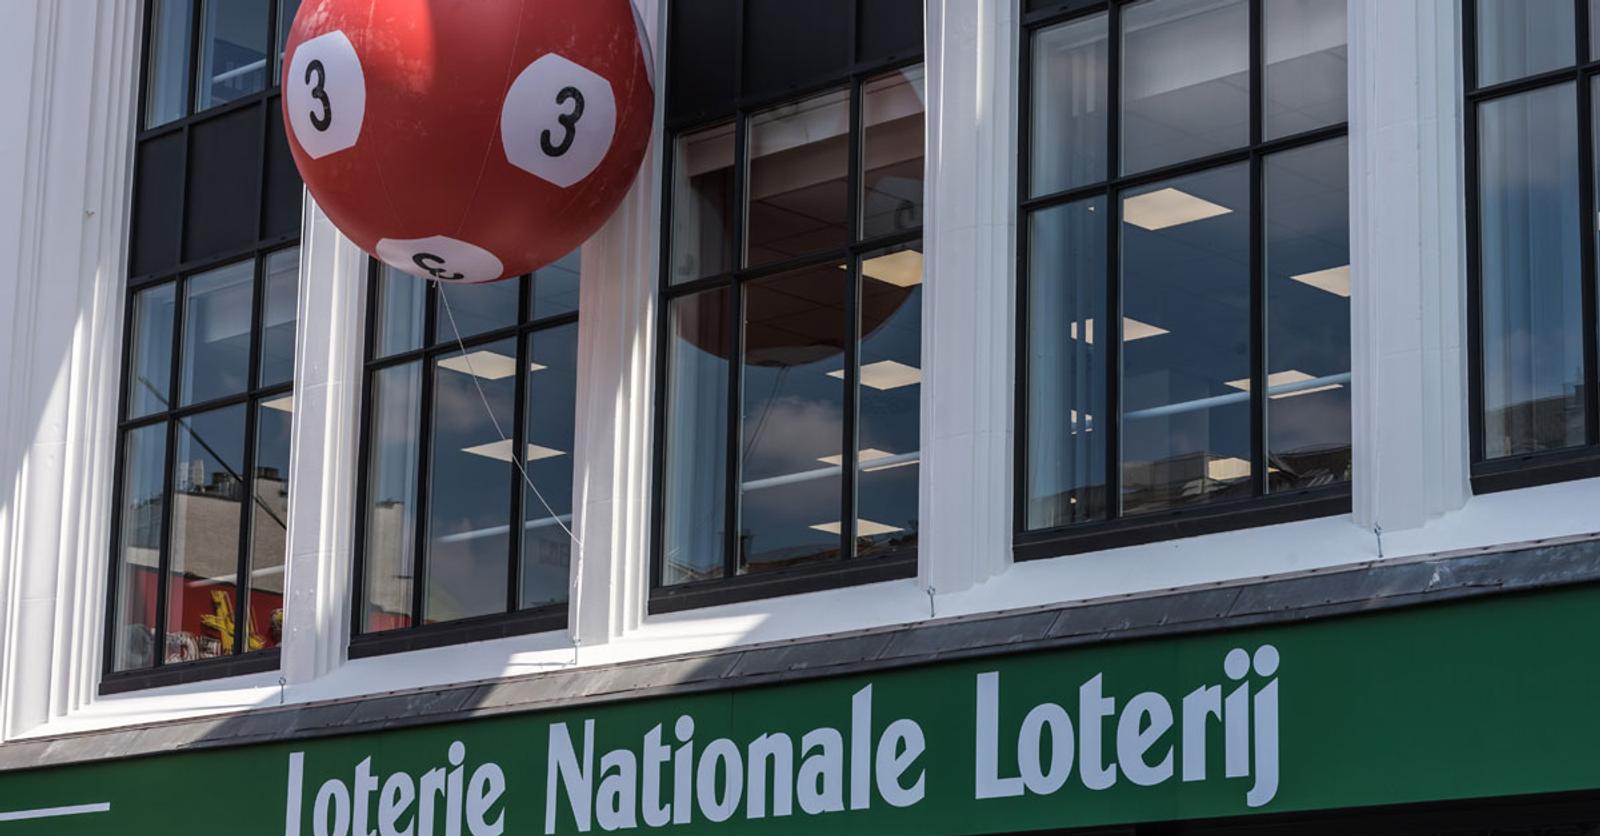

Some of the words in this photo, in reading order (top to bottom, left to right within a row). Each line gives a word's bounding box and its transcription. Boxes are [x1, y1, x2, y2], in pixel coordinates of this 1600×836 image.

[305, 59, 332, 132] 3
[540, 86, 585, 158] 3
[544, 683, 926, 835] Nationale
[975, 644, 1280, 807] Loterij
